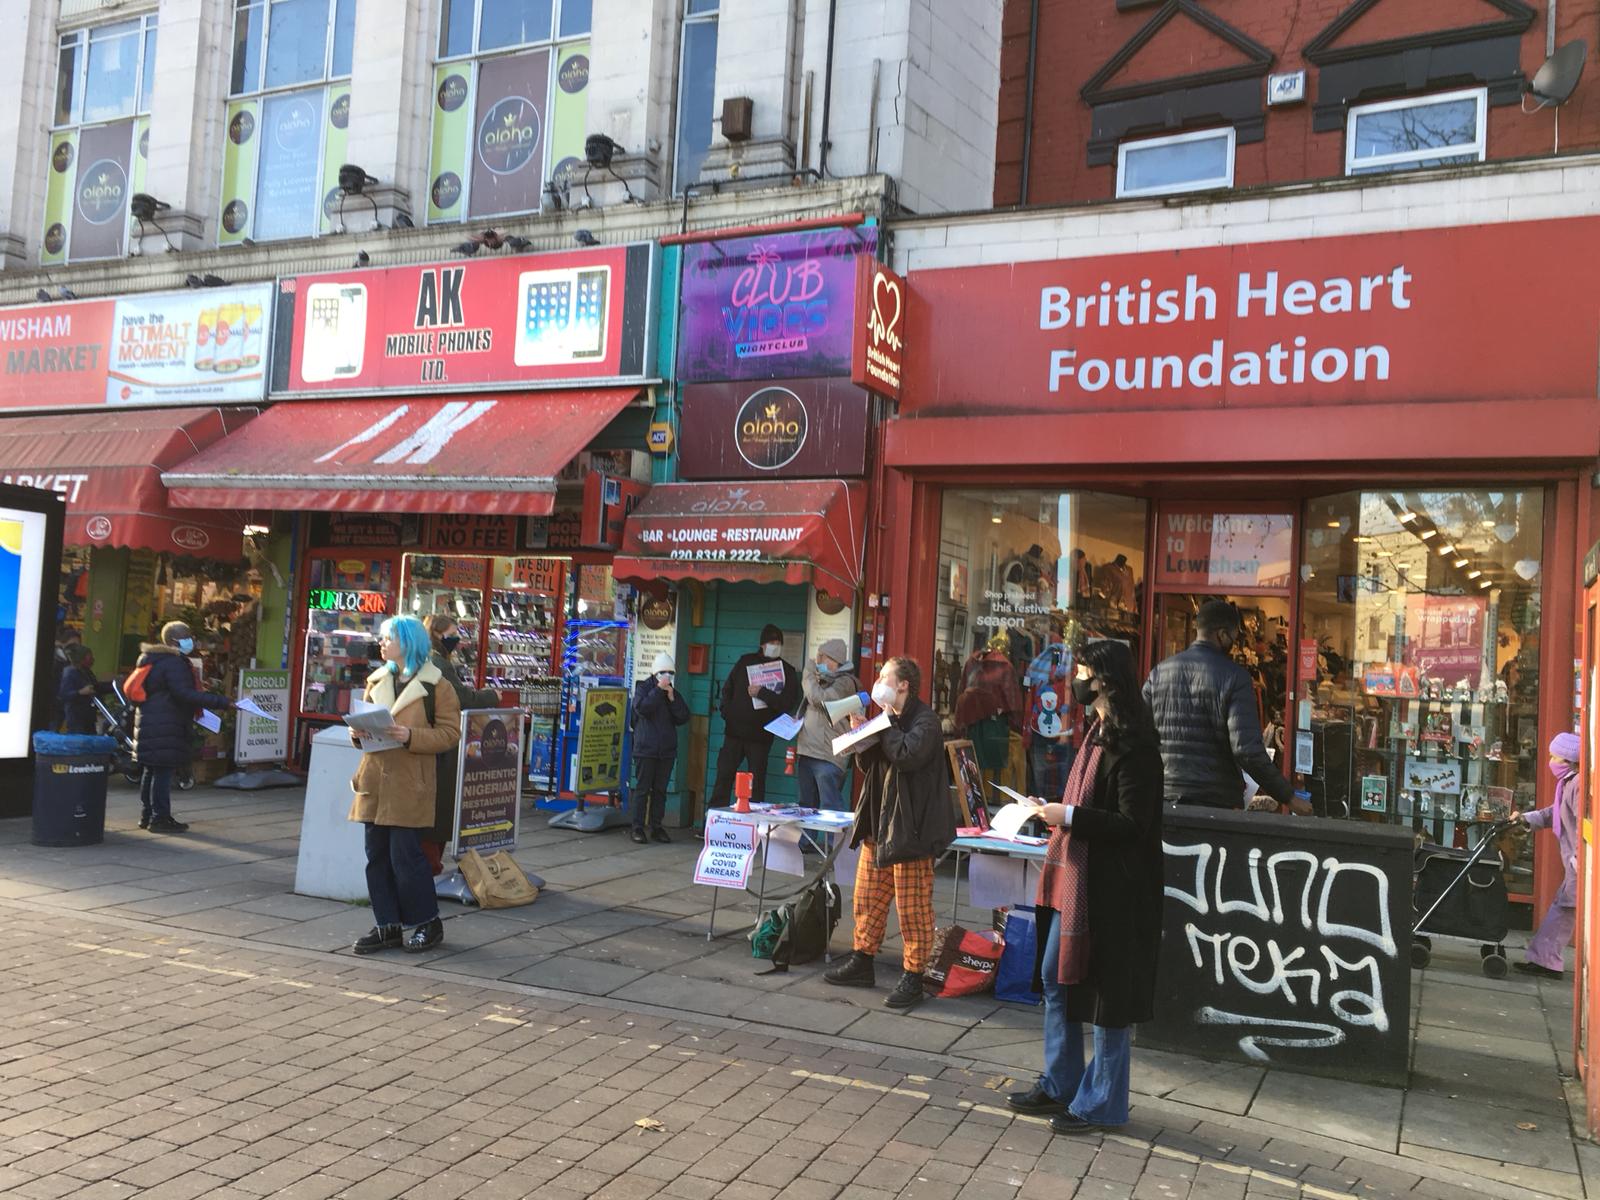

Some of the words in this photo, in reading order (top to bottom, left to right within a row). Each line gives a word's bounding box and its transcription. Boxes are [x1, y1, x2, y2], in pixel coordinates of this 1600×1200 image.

[731, 259, 824, 307] CLUB
[415, 267, 465, 330] AK
[1039, 275, 1217, 331] British
[1236, 265, 1412, 318] Heart
[122, 315, 145, 326] have
[149, 312, 164, 324] the
[721, 301, 828, 343] VIBES
[386, 332, 434, 358] MOBILE
[437, 328, 492, 353] PHONES
[739, 339, 805, 354] NIGHTCLUB
[119, 340, 189, 362] MOMENT
[5, 342, 101, 376] MARKET
[867, 345, 886, 367] British
[885, 354, 900, 376] Heart
[1048, 336, 1391, 393] Foundation
[422, 359, 447, 382] LTD.
[867, 359, 900, 390] Foundation
[550, 522, 580, 534] MOB
[1167, 514, 1254, 534] Welcome
[436, 528, 466, 546] NO
[472, 527, 508, 546] FEE
[550, 534, 580, 548] PHO
[642, 528, 663, 543] BAR
[672, 528, 718, 542] LOUNGE
[727, 527, 804, 542] RESTAURANT
[1166, 536, 1184, 552] to
[730, 549, 761, 561] 2222
[517, 559, 533, 570] WE
[537, 559, 556, 573] BUY
[1166, 554, 1260, 575] Lewisham
[529, 571, 554, 592] SELL
[984, 590, 1003, 601] Shop
[992, 602, 1012, 613] this
[1014, 602, 1050, 614] festive
[977, 615, 1025, 628] season
[1418, 613, 1461, 625] wrapped
[1463, 615, 1476, 625] up
[246, 677, 286, 689] OBIGOLD
[253, 694, 279, 704] MONEY
[258, 703, 283, 713] ANSFER
[246, 738, 279, 747] GLOBALLY
[68, 764, 104, 774] Lewisham
[464, 768, 516, 783] AUTHENTIC
[464, 780, 516, 798] NIGERIAN
[462, 796, 515, 809] RESTAURANT
[724, 832, 737, 840] NO
[709, 839, 752, 851] EVICTIONS
[710, 851, 744, 861] FORGIVE
[712, 859, 737, 869] COVID
[704, 868, 741, 878] ARREARS
